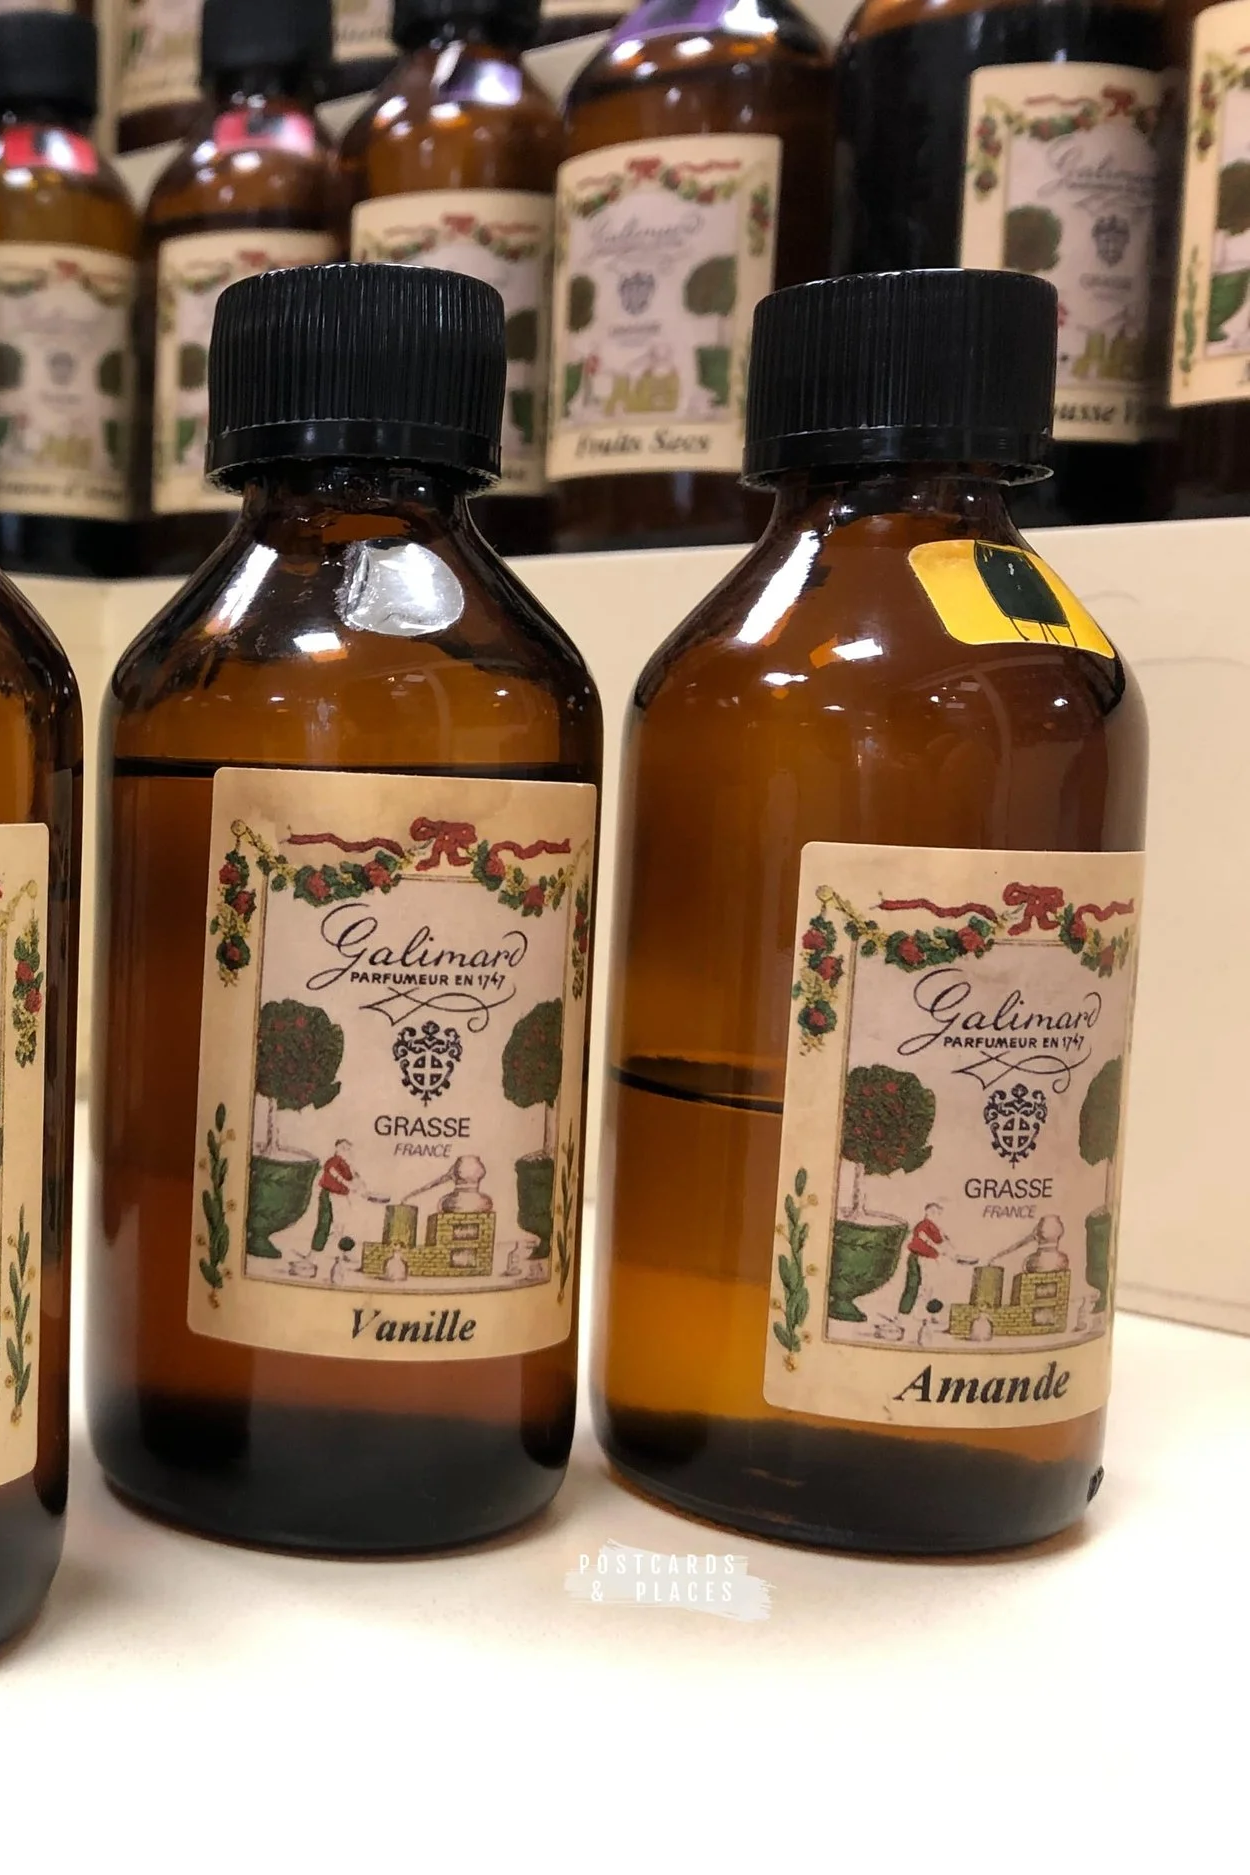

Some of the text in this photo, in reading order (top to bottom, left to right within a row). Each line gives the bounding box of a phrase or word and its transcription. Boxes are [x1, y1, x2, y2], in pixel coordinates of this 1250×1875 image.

[575, 428, 710, 457] Fruits Secs
[306, 903, 528, 990] Galimard
[350, 971, 505, 991] PARFUMEUR EN 1747
[897, 968, 1101, 1056] Galimard
[943, 1033, 1084, 1051] PARFUMEUR EN 1747
[374, 1115, 470, 1138] GRASSE
[393, 1142, 452, 1158] FRANCE
[964, 1178, 1053, 1199] GRASSE
[982, 1204, 1037, 1219] FRANCE
[352, 1308, 476, 1342] Vanille
[892, 1361, 1070, 1403] Amande
